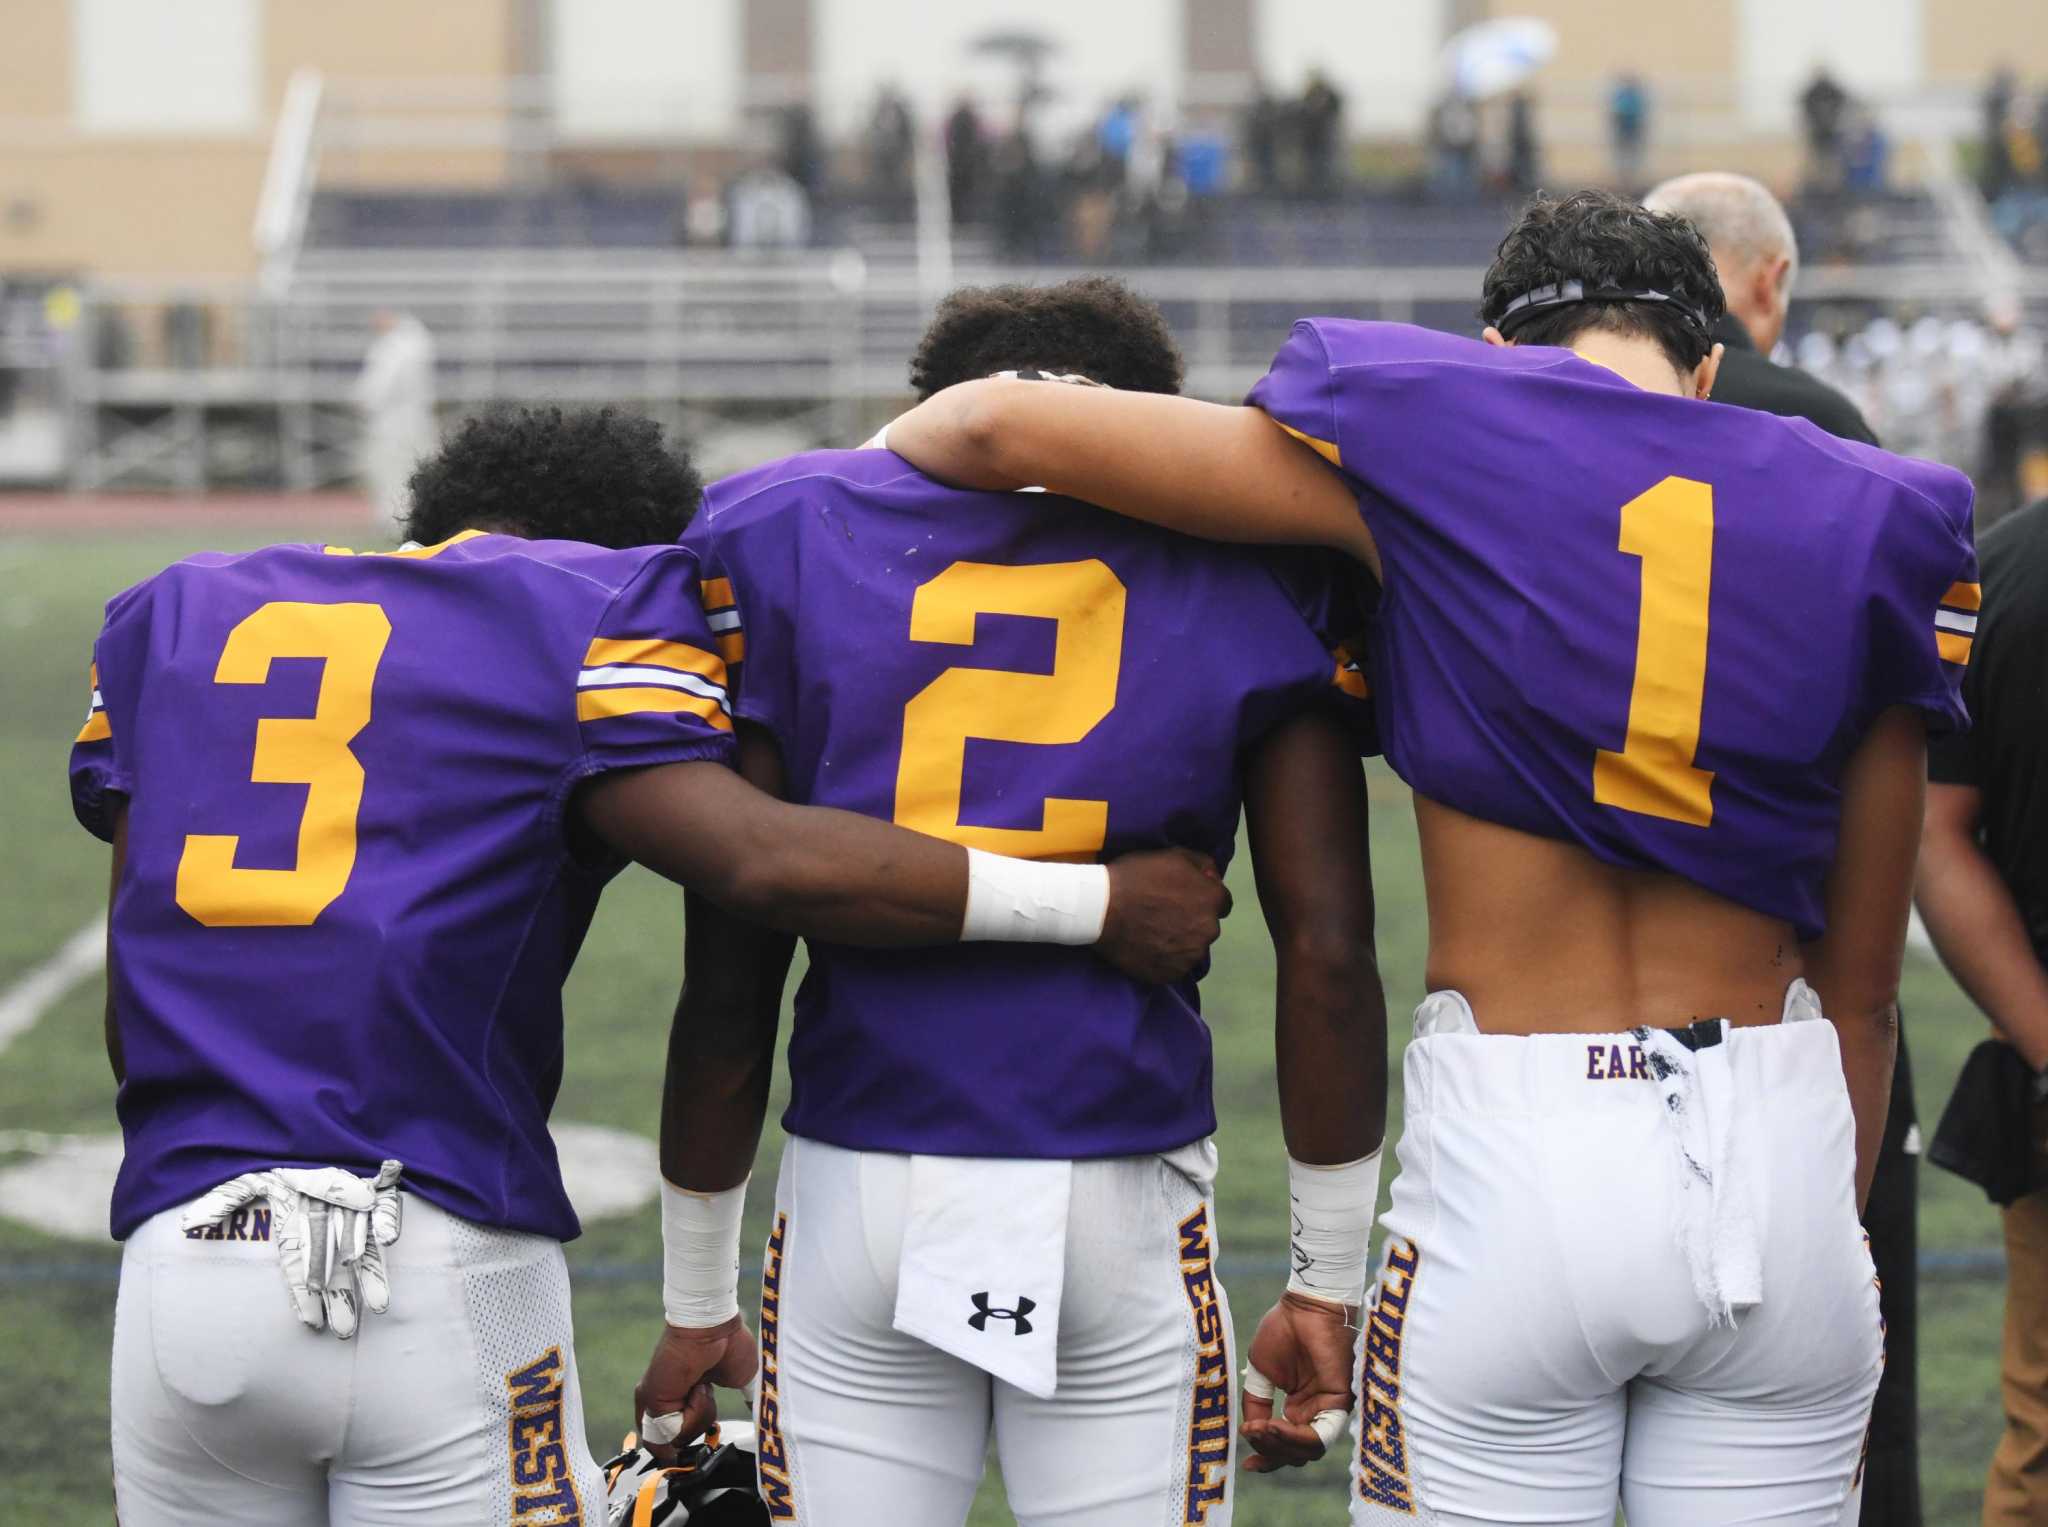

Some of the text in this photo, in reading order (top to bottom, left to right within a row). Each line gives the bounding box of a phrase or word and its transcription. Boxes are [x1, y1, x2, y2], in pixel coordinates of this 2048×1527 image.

[176, 602, 392, 927] 3
[894, 558, 1127, 862] 2
[1593, 475, 1715, 827] 1
[1586, 1044, 1655, 1080] EAR
[506, 1344, 584, 1527] WEST
[758, 1212, 796, 1521] WESTHILL
[1178, 1202, 1230, 1526] WESTHILL
[1359, 1236, 1419, 1516] WESTHILL
